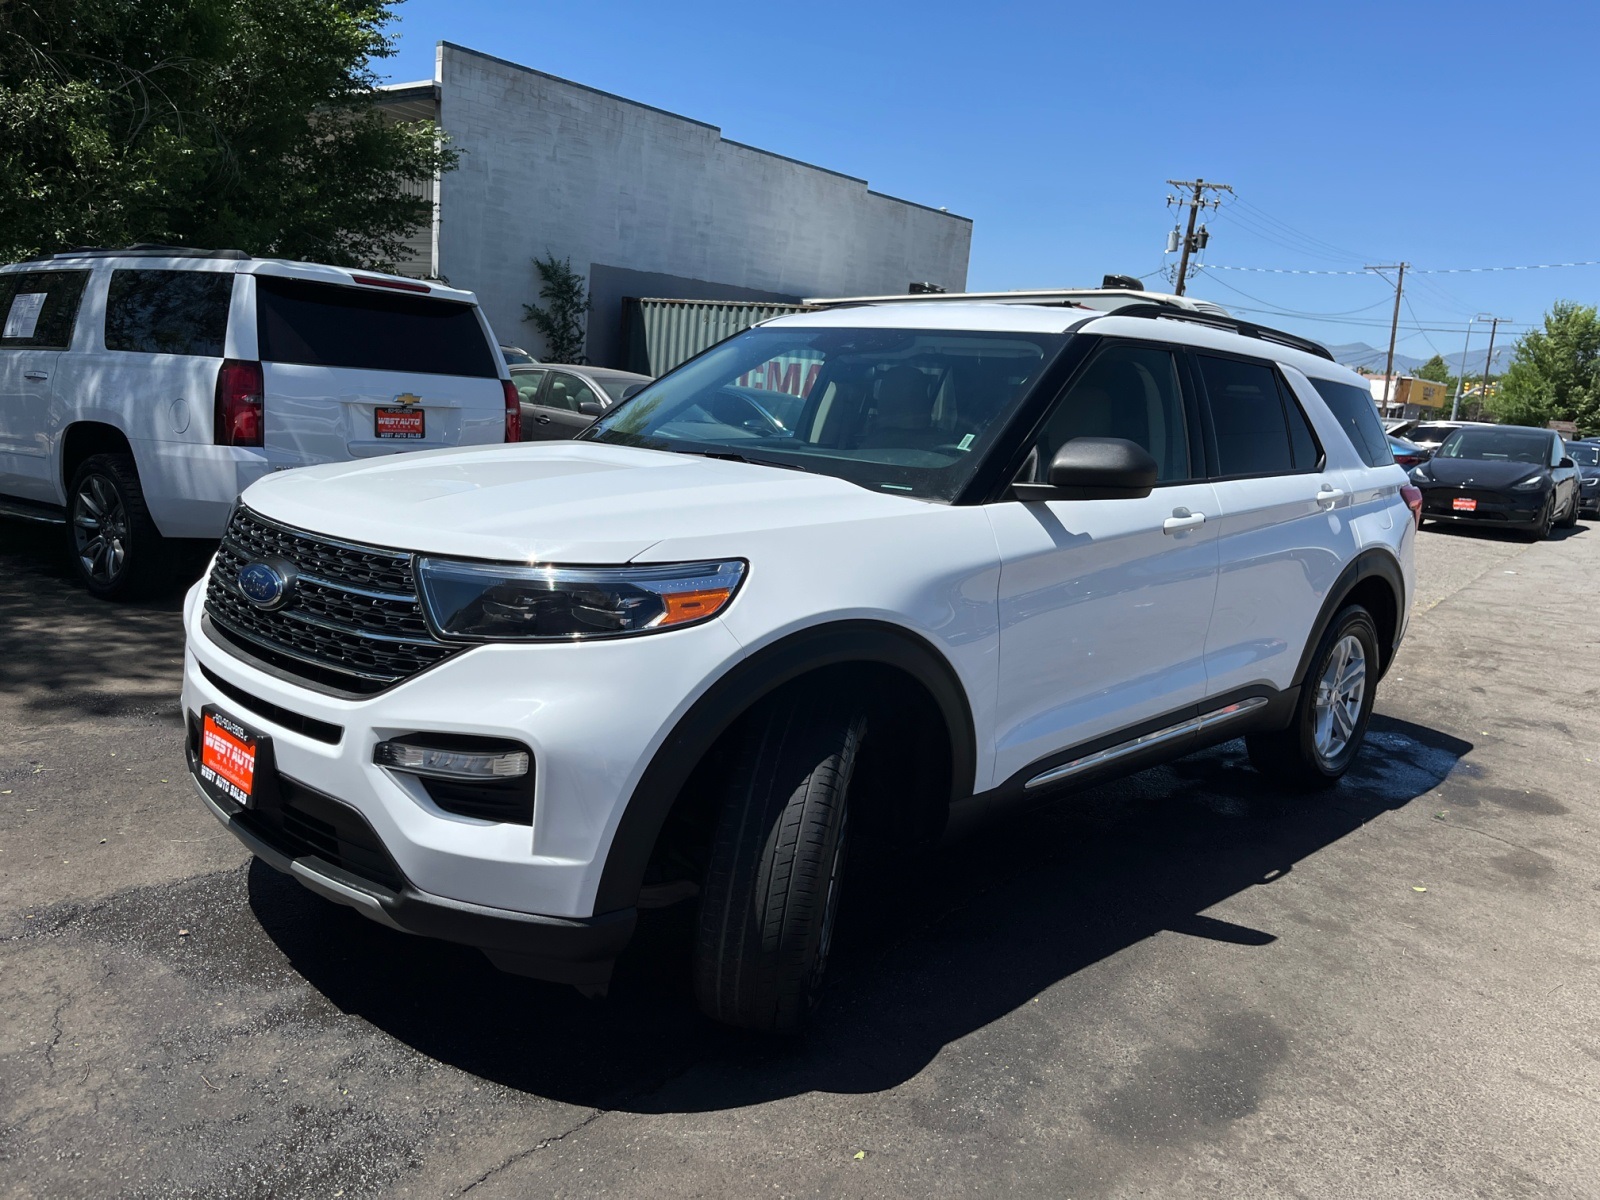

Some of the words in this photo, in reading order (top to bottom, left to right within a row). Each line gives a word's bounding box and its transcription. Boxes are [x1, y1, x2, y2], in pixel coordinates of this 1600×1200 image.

[378, 417, 399, 425] WEST
[205, 730, 232, 757] WEST
[232, 747, 254, 773] AUTO
[217, 753, 244, 775] SALES
[201, 764, 216, 782] WEST
[216, 774, 230, 793] AUTO
[229, 784, 247, 805] SALES
